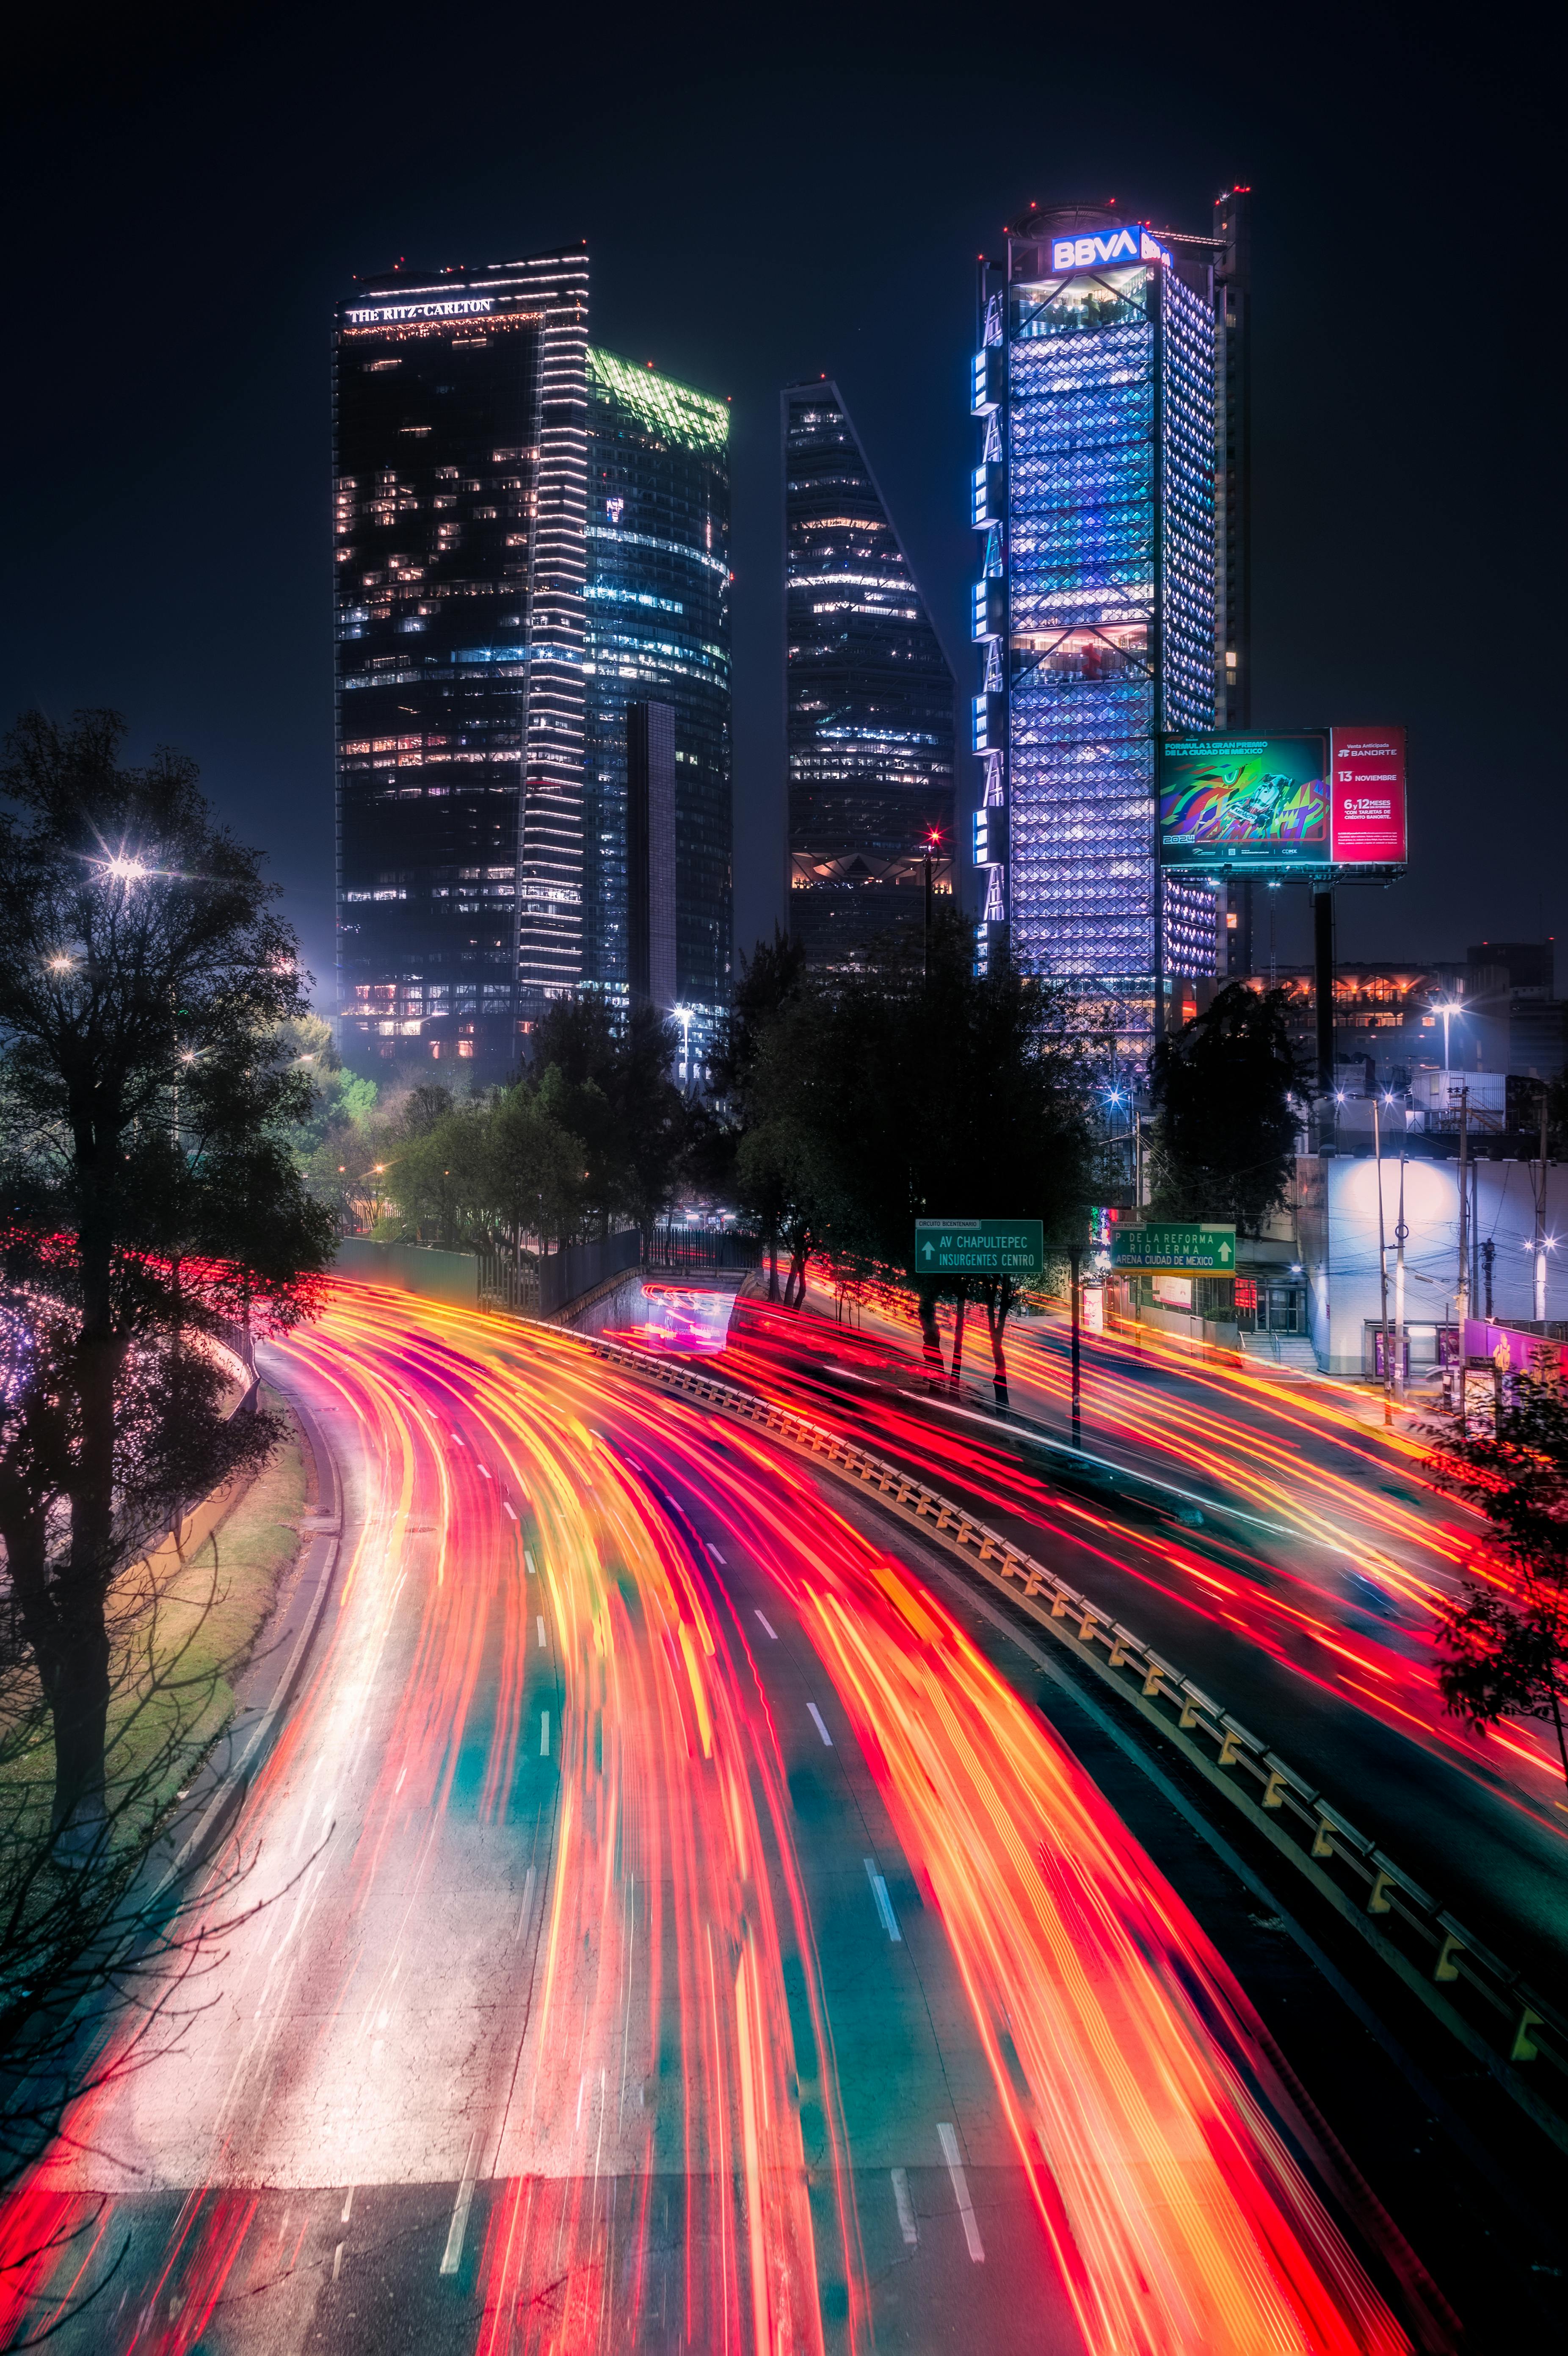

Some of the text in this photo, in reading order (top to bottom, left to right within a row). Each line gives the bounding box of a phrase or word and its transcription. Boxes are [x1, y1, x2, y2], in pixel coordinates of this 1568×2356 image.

[1054, 230, 1137, 270] BBVA
[350, 309, 379, 323] THE
[1338, 771, 1353, 782] 13
[1163, 835, 1195, 844] 2024
[940, 1236, 1027, 1248] AV CHAPULTEPEC
[1115, 1233, 1213, 1244] P. DE LA REFORMA
[1130, 1244, 1199, 1254] RIO LERMA
[939, 1254, 1034, 1266] INSURGENTES CENTRO
[1116, 1255, 1213, 1266] ARENA CIUDAD DE MEXICO
